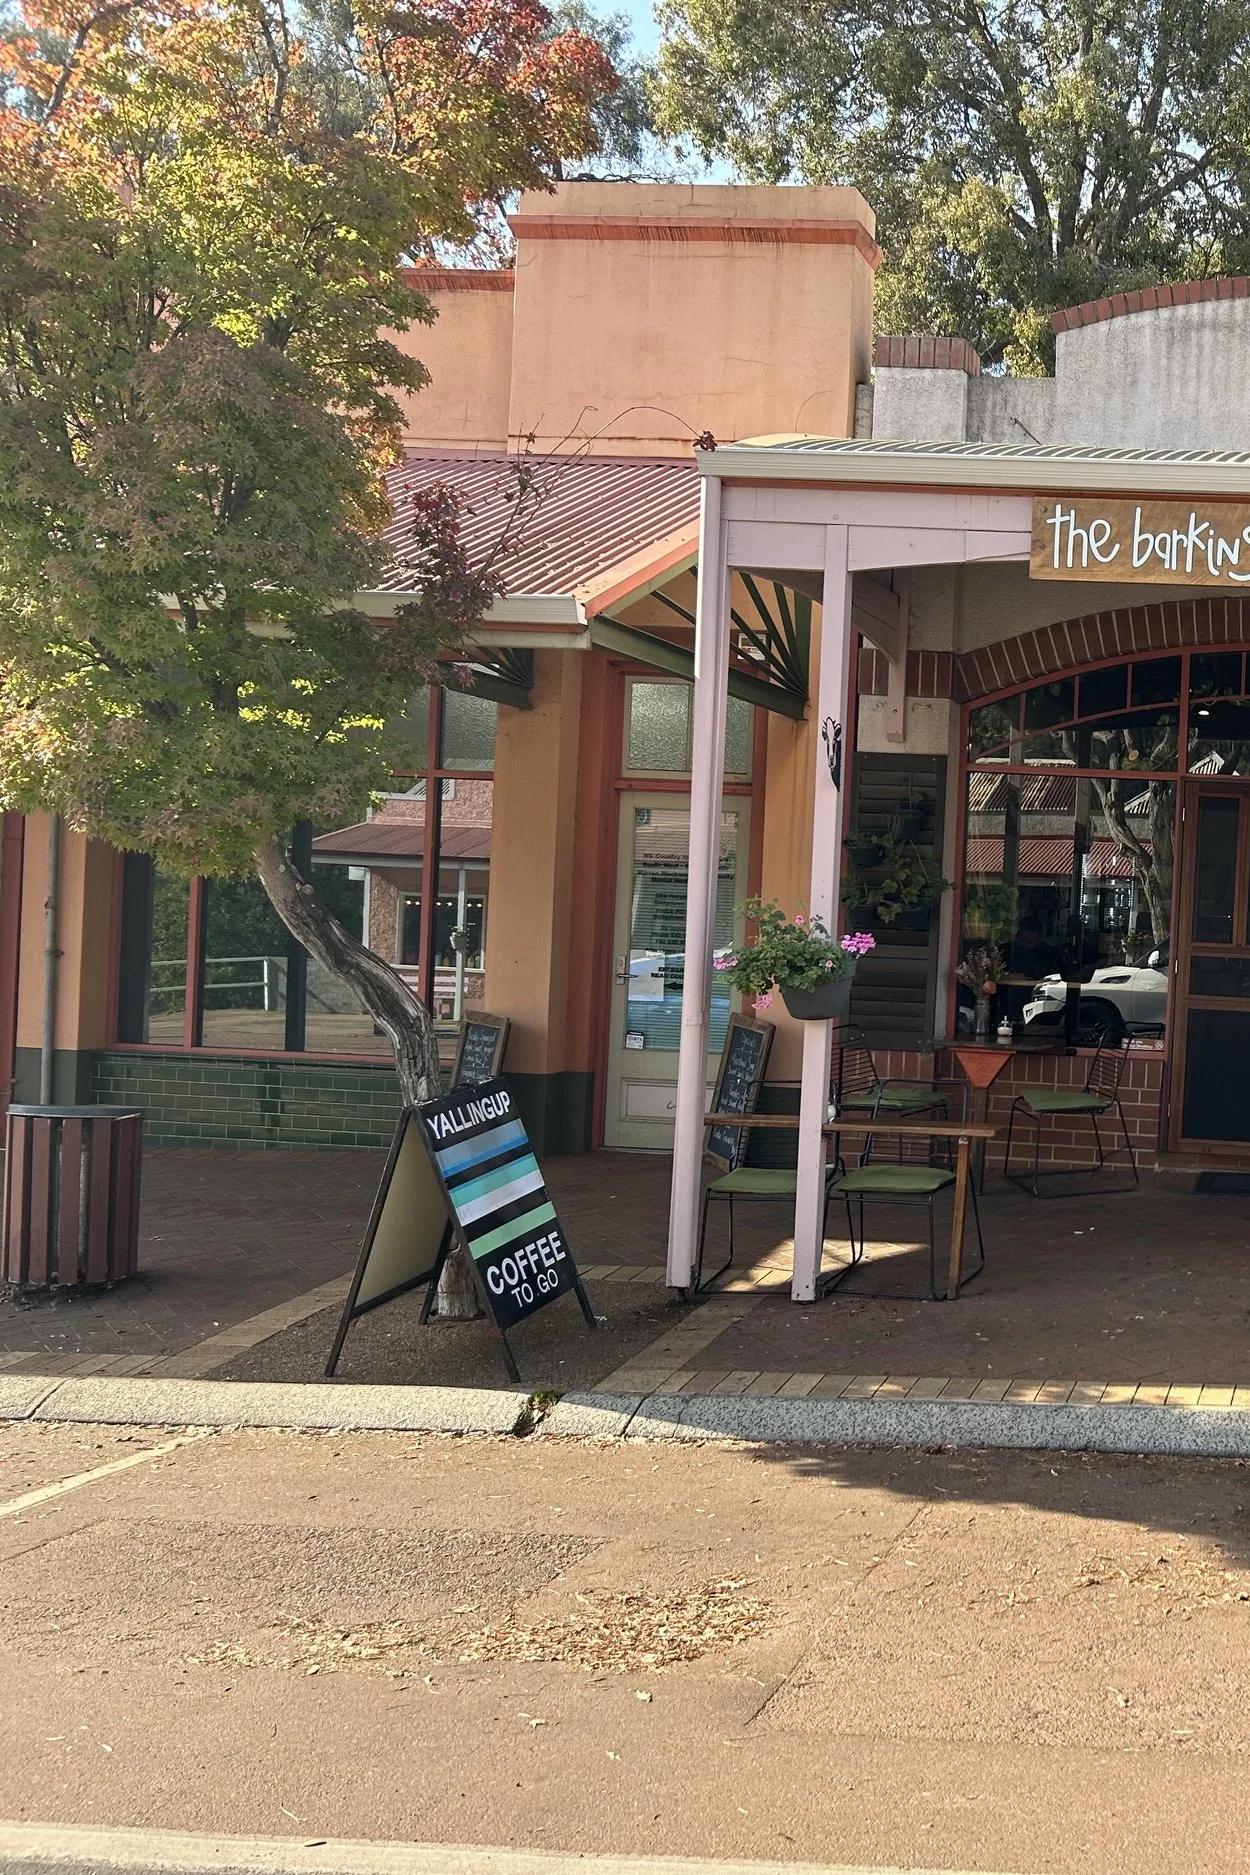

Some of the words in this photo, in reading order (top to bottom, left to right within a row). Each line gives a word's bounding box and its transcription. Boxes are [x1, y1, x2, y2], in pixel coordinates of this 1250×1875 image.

[1046, 503, 1121, 570] the
[426, 1090, 511, 1140] YALLINGUP
[486, 1230, 567, 1295] COFFEE
[510, 1282, 534, 1308] TO
[537, 1268, 559, 1294] GO
